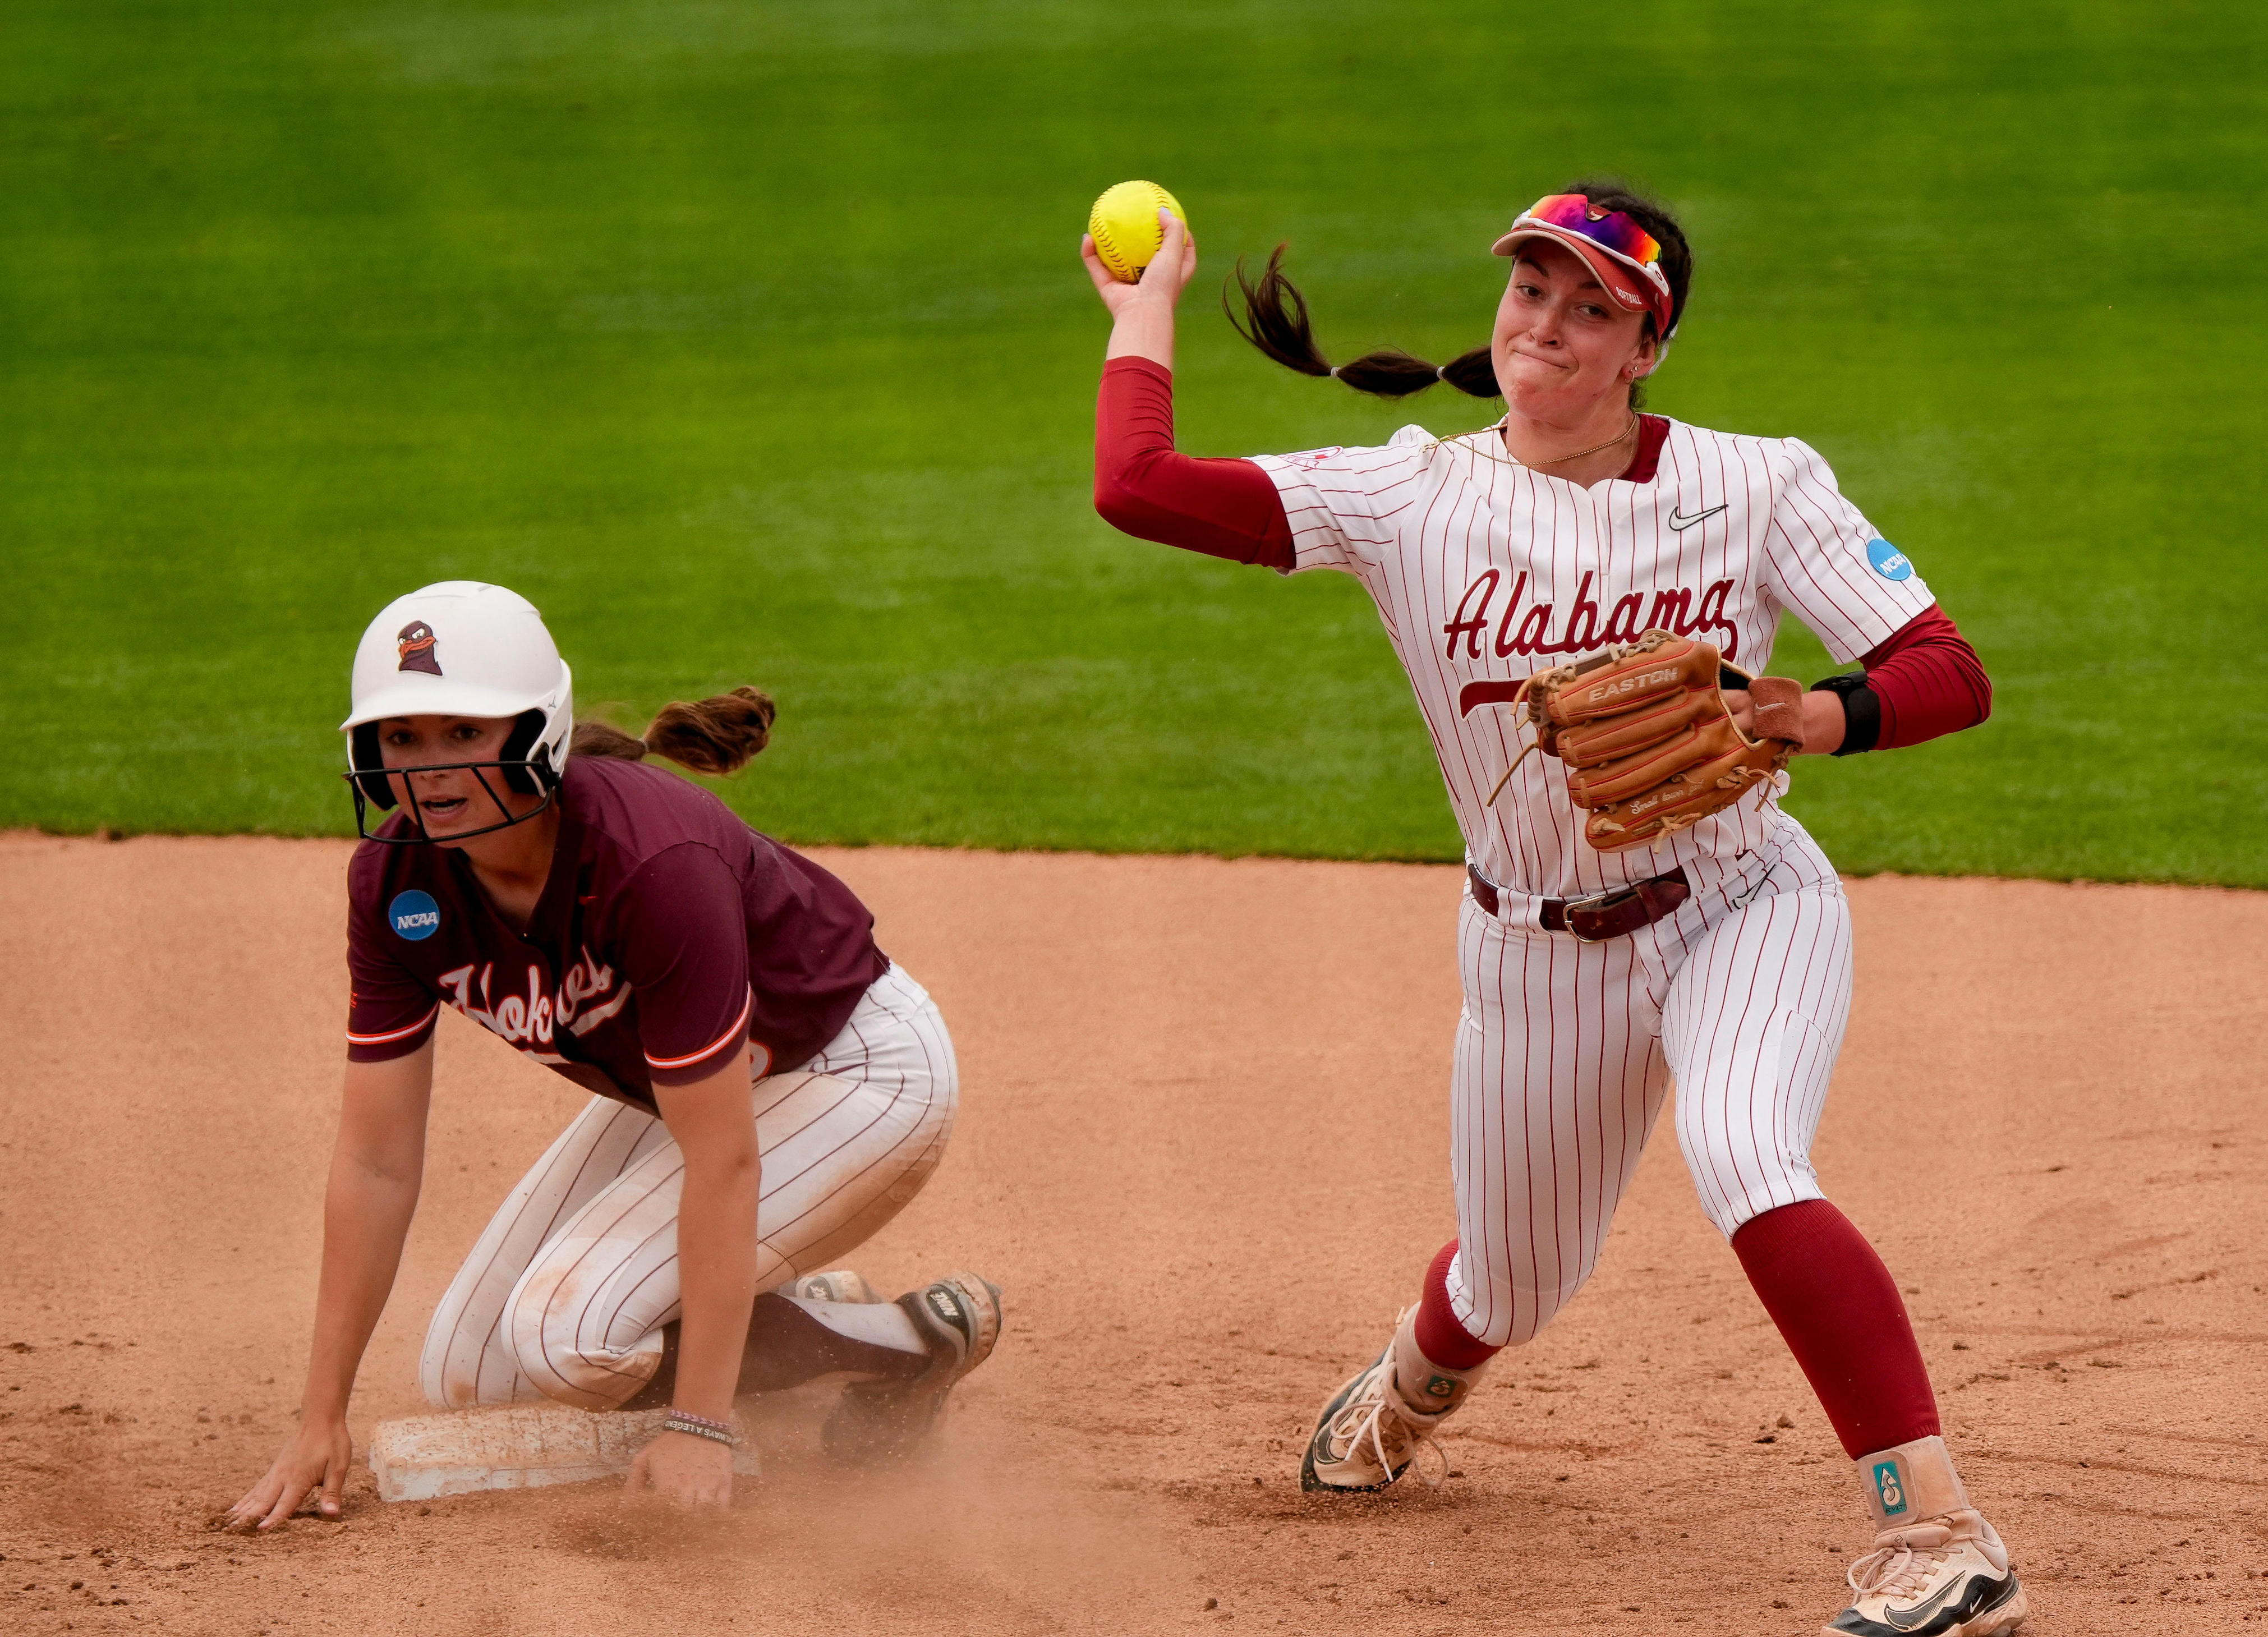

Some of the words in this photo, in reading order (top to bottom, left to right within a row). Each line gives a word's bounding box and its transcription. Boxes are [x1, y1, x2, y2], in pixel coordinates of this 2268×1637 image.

[1880, 553, 1906, 574] NCAA
[1443, 568, 1739, 664] Alabama
[1589, 667, 1678, 703] EASTON
[397, 912, 438, 929] NCAA
[439, 944, 613, 1043] Hokies
[1886, 1505, 1903, 1513] EVO
